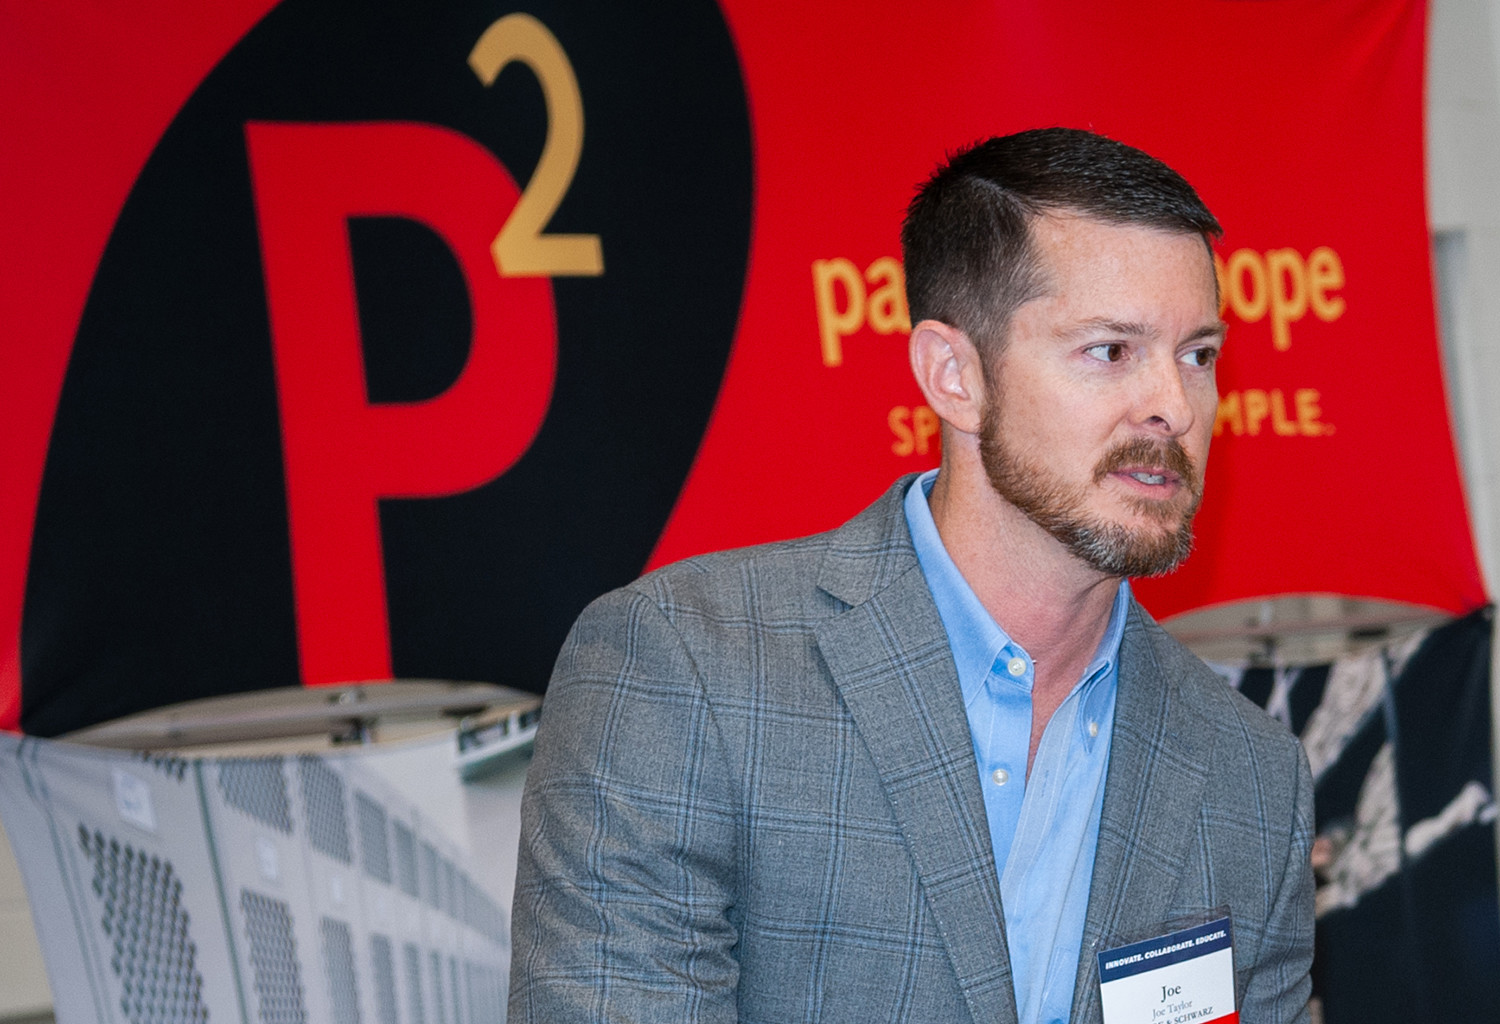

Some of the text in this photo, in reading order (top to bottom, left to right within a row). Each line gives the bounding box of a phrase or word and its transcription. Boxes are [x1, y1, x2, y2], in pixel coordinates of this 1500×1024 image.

[1105, 930, 1227, 970] INNOVATE. COLLABORATE. EDUCATE.
[1161, 984, 1182, 1003] Joe
[1152, 999, 1193, 1021] Joe Taylor
